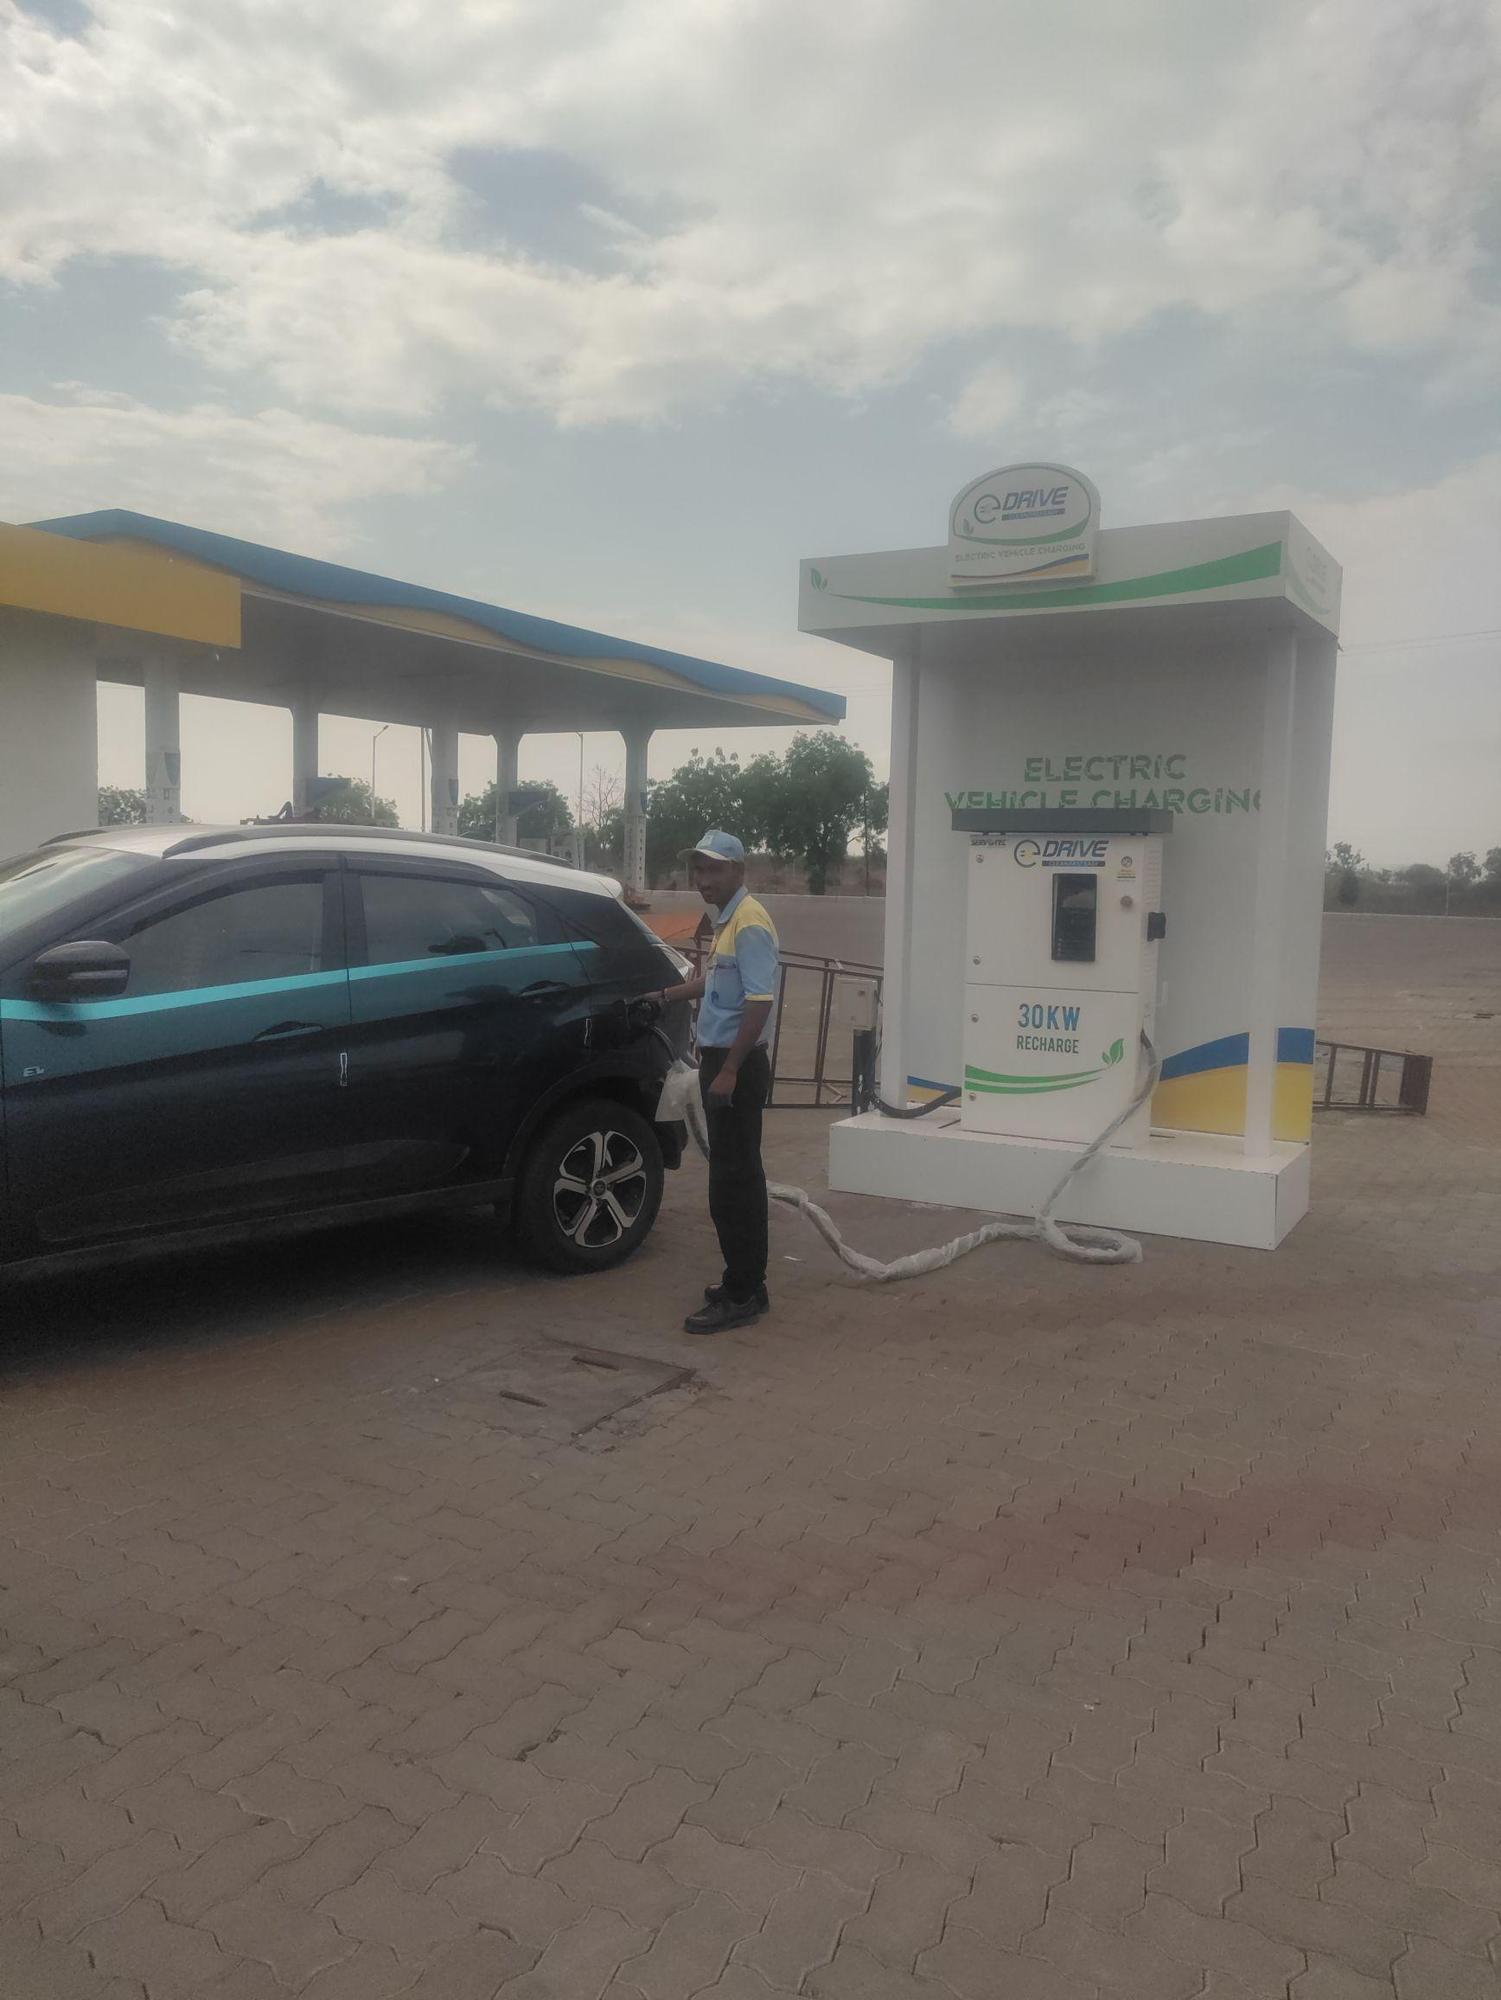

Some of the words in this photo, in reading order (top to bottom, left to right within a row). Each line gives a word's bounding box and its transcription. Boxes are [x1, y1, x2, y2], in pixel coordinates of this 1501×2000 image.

[955, 551, 996, 562] ELECTRIC
[998, 546, 1036, 558] VEHICLE
[1038, 542, 1087, 554] CHARGING
[1024, 754, 1187, 782] ELECTRIC
[1092, 788, 1261, 815] CHARGIN
[1018, 1003, 1080, 1031] 30KW
[1017, 1035, 1079, 1054] RECHARGE
